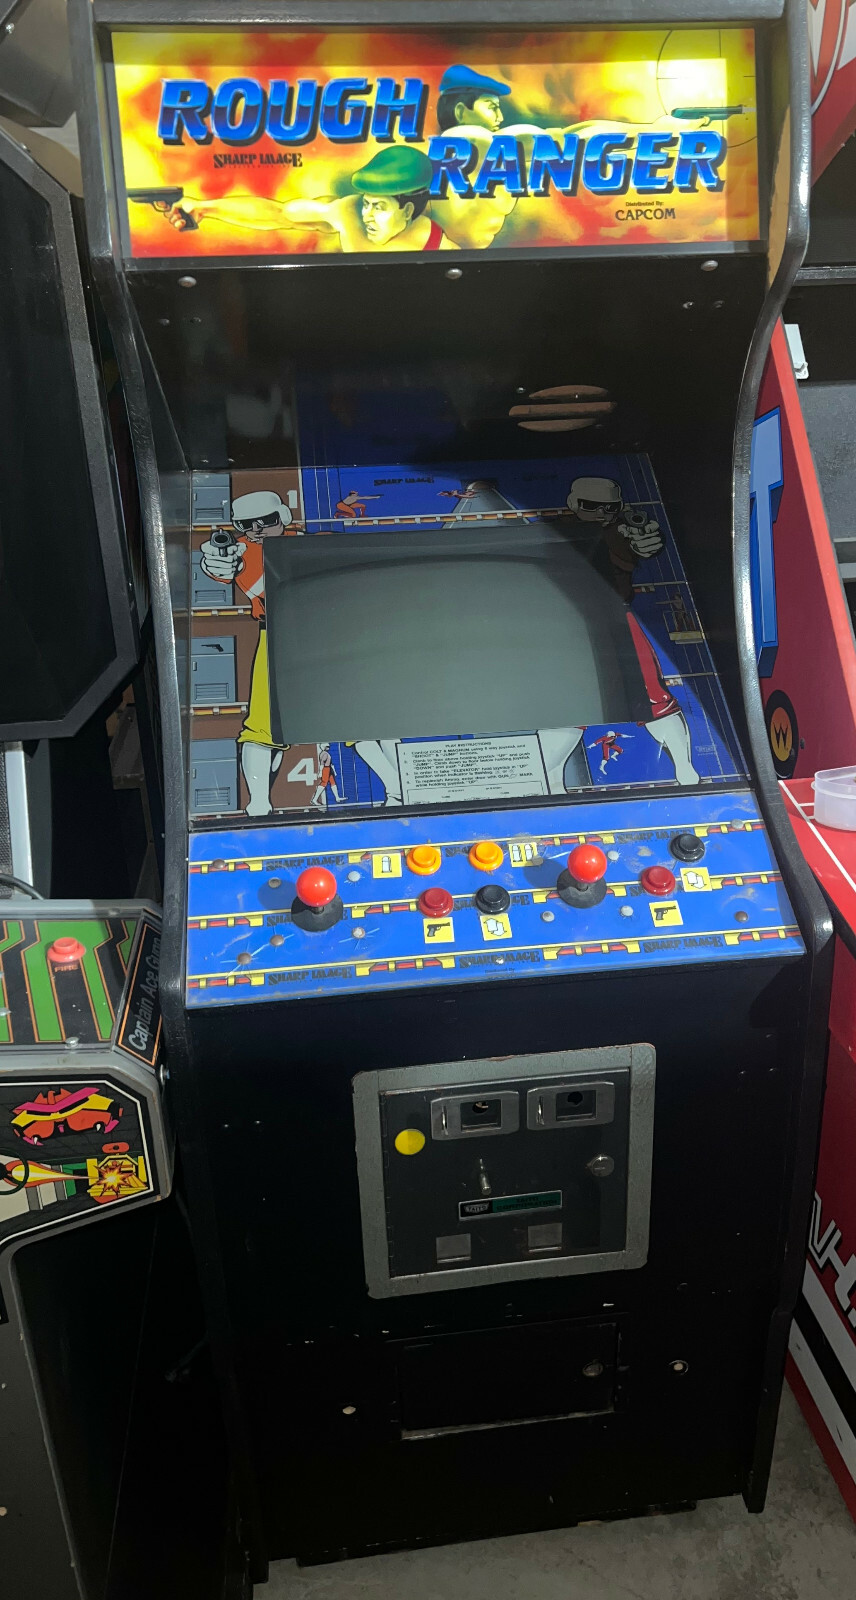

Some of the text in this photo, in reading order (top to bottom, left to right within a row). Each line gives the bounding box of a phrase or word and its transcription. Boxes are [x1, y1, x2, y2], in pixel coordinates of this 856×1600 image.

[158, 77, 428, 144] ROUGH
[213, 153, 303, 168] SHARP IMAGE
[428, 131, 726, 197] RANGER
[615, 208, 676, 221] CAPCOM
[286, 489, 298, 509] 1
[287, 758, 318, 786] 4
[266, 855, 345, 872] SHARP IMAGE
[267, 914, 292, 927] SHA
[643, 936, 723, 953] SHARP IMAGE
[140, 970, 159, 999] Ace
[266, 965, 351, 986] SHARP IMAGE
[128, 997, 154, 1051] Captain
